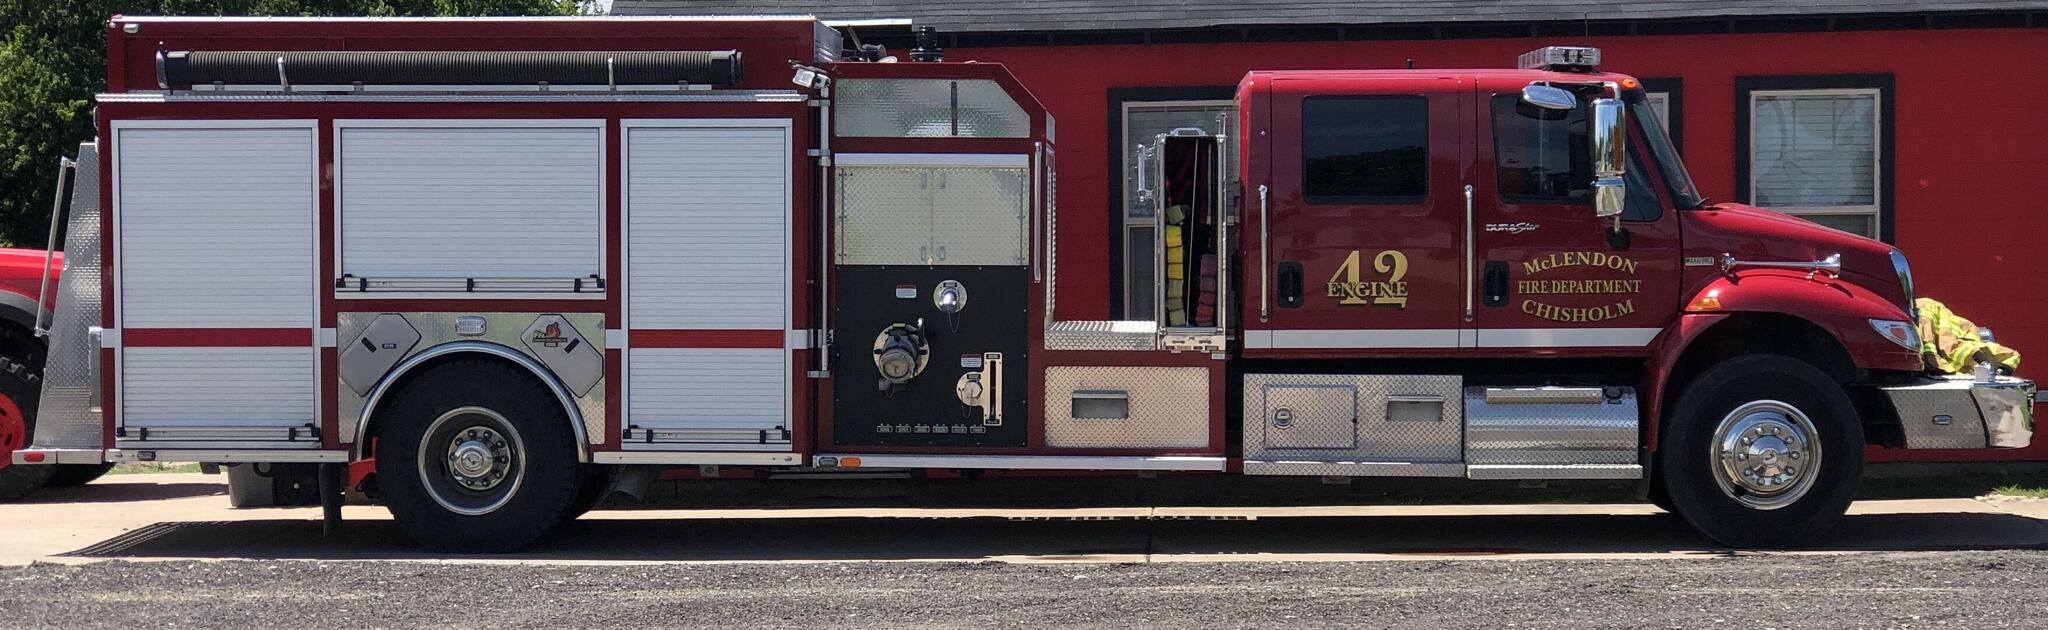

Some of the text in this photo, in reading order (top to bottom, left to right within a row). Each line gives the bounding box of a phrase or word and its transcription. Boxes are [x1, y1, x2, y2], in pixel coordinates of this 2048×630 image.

[1523, 251, 1638, 275] McLENDON
[1327, 281, 1408, 297] ENGINE
[1328, 250, 1408, 308] 42
[1518, 280, 1641, 294] FIRE DEPARTMENT
[1522, 299, 1635, 322] CHISHOLM
